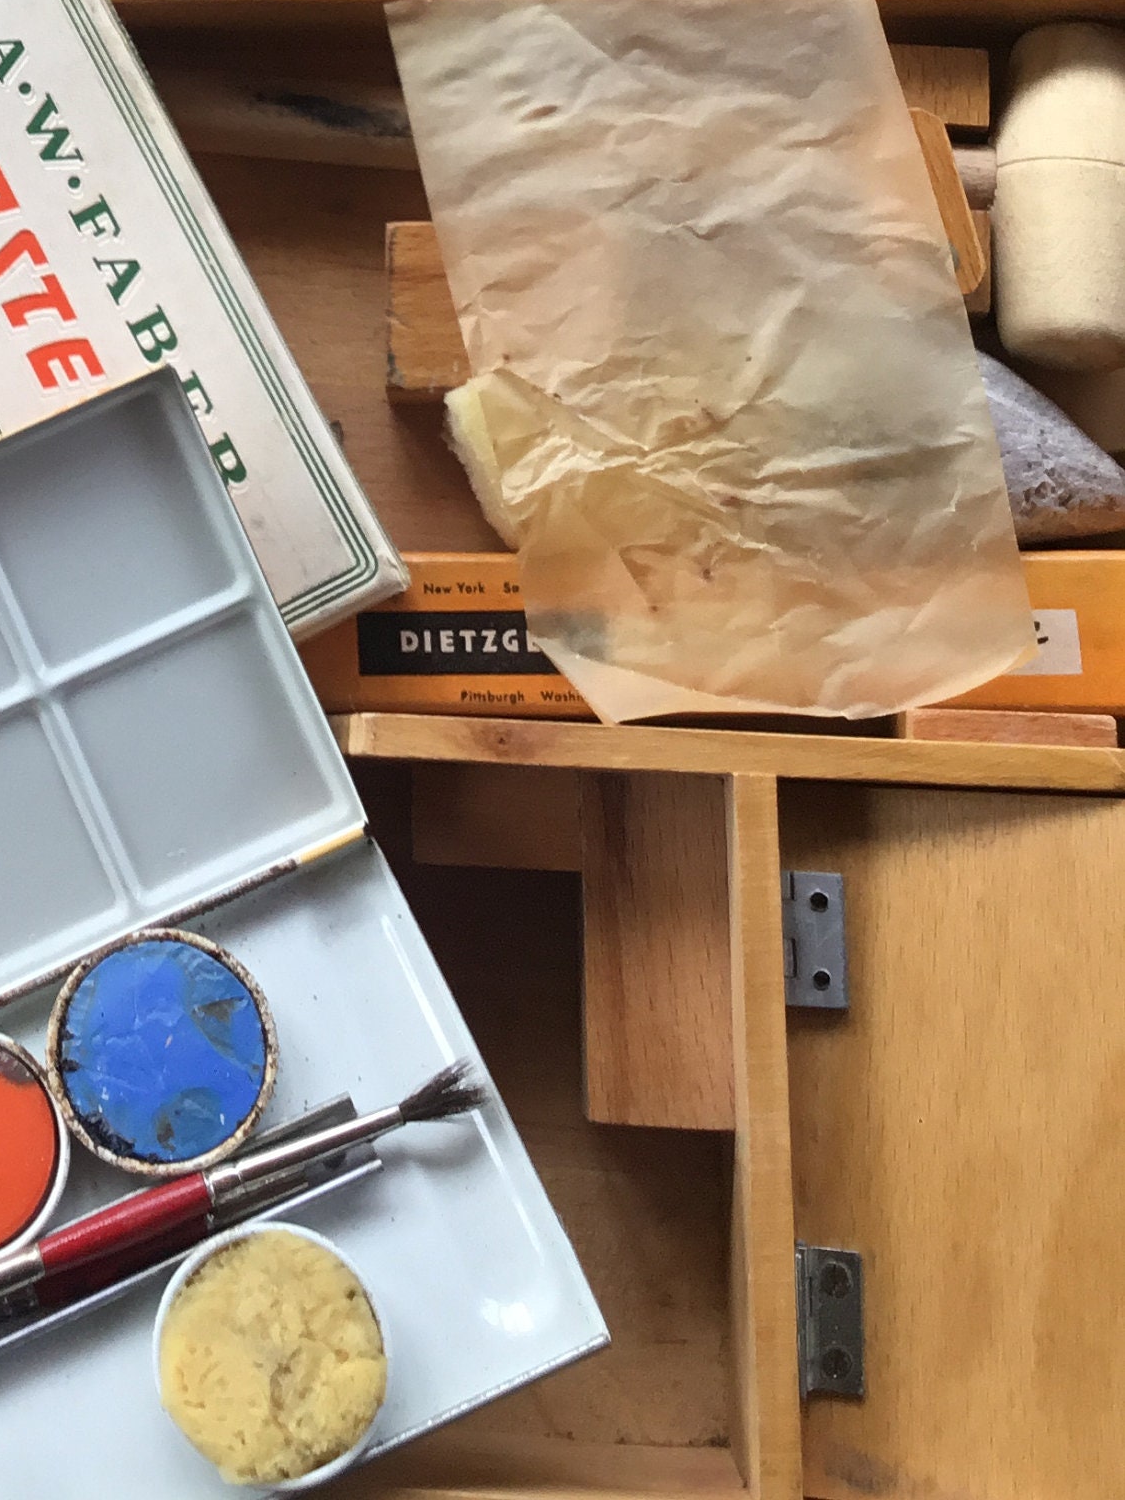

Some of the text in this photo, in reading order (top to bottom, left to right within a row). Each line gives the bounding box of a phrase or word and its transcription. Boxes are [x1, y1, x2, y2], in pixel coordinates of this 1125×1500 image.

[423, 582, 452, 595] New
[457, 581, 486, 595] York
[459, 690, 525, 706] Pittsburgh
